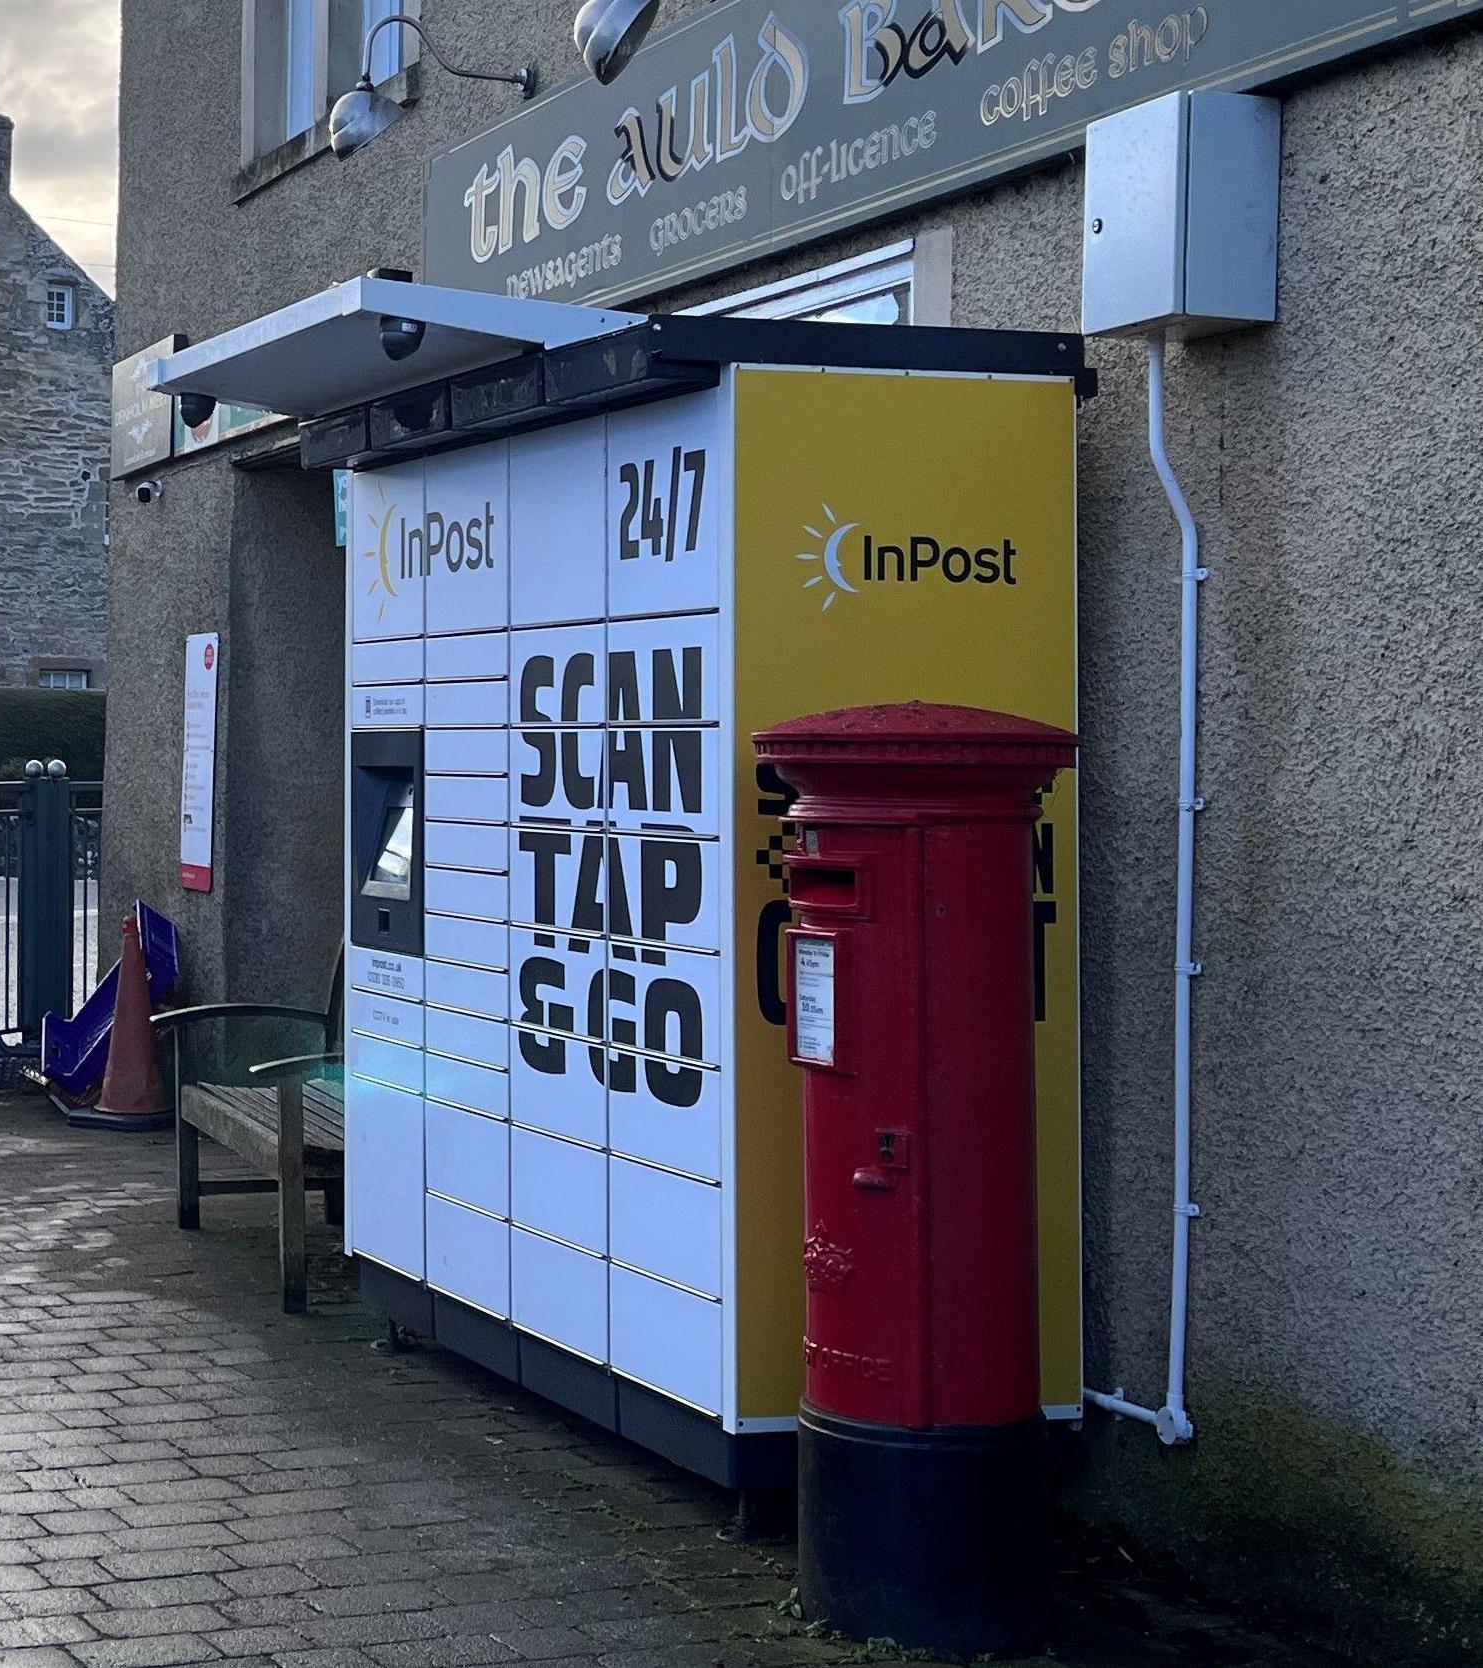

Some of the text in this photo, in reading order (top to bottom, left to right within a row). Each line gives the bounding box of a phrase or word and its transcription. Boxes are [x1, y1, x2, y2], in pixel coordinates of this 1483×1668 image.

[464, 135, 588, 263] the
[506, 233, 622, 300] newsagents
[980, 46, 1098, 126] coffee
[1108, 6, 1208, 79] shop
[400, 502, 495, 580] InPost
[619, 445, 707, 563] 24/7
[863, 535, 1017, 585] InPost
[520, 646, 703, 814] SCAN
[520, 815, 704, 966] TAP
